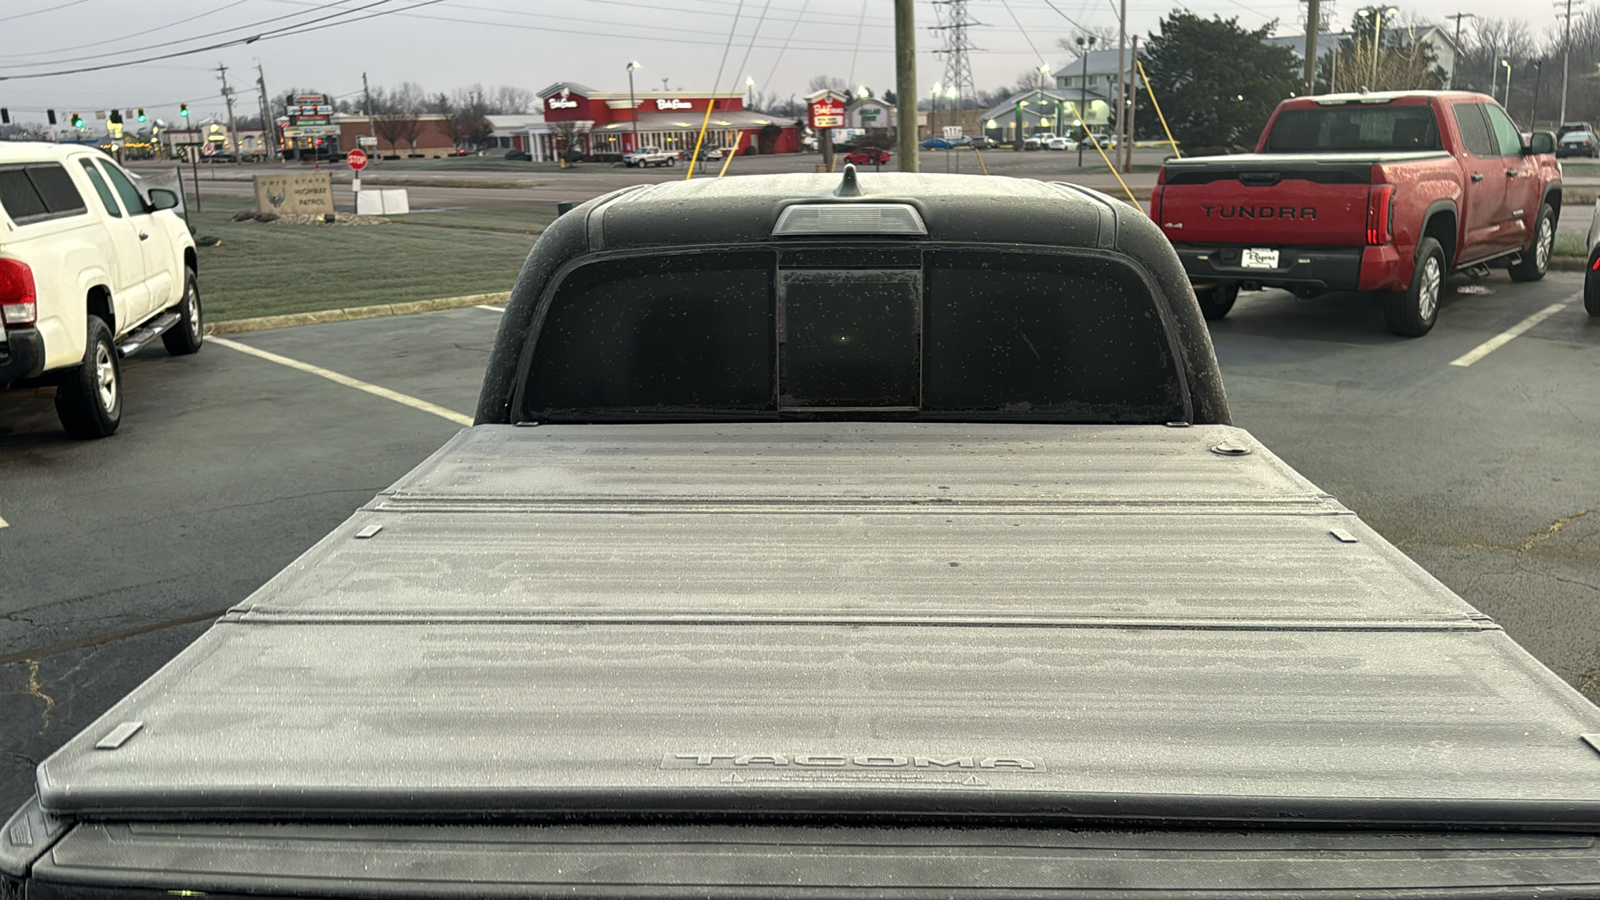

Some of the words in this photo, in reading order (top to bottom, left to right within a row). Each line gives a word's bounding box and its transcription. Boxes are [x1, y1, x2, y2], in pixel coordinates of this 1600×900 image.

[347, 155, 366, 164] STOP
[1201, 205, 1318, 220] TUNDRA
[675, 753, 1036, 770] TACOMA
